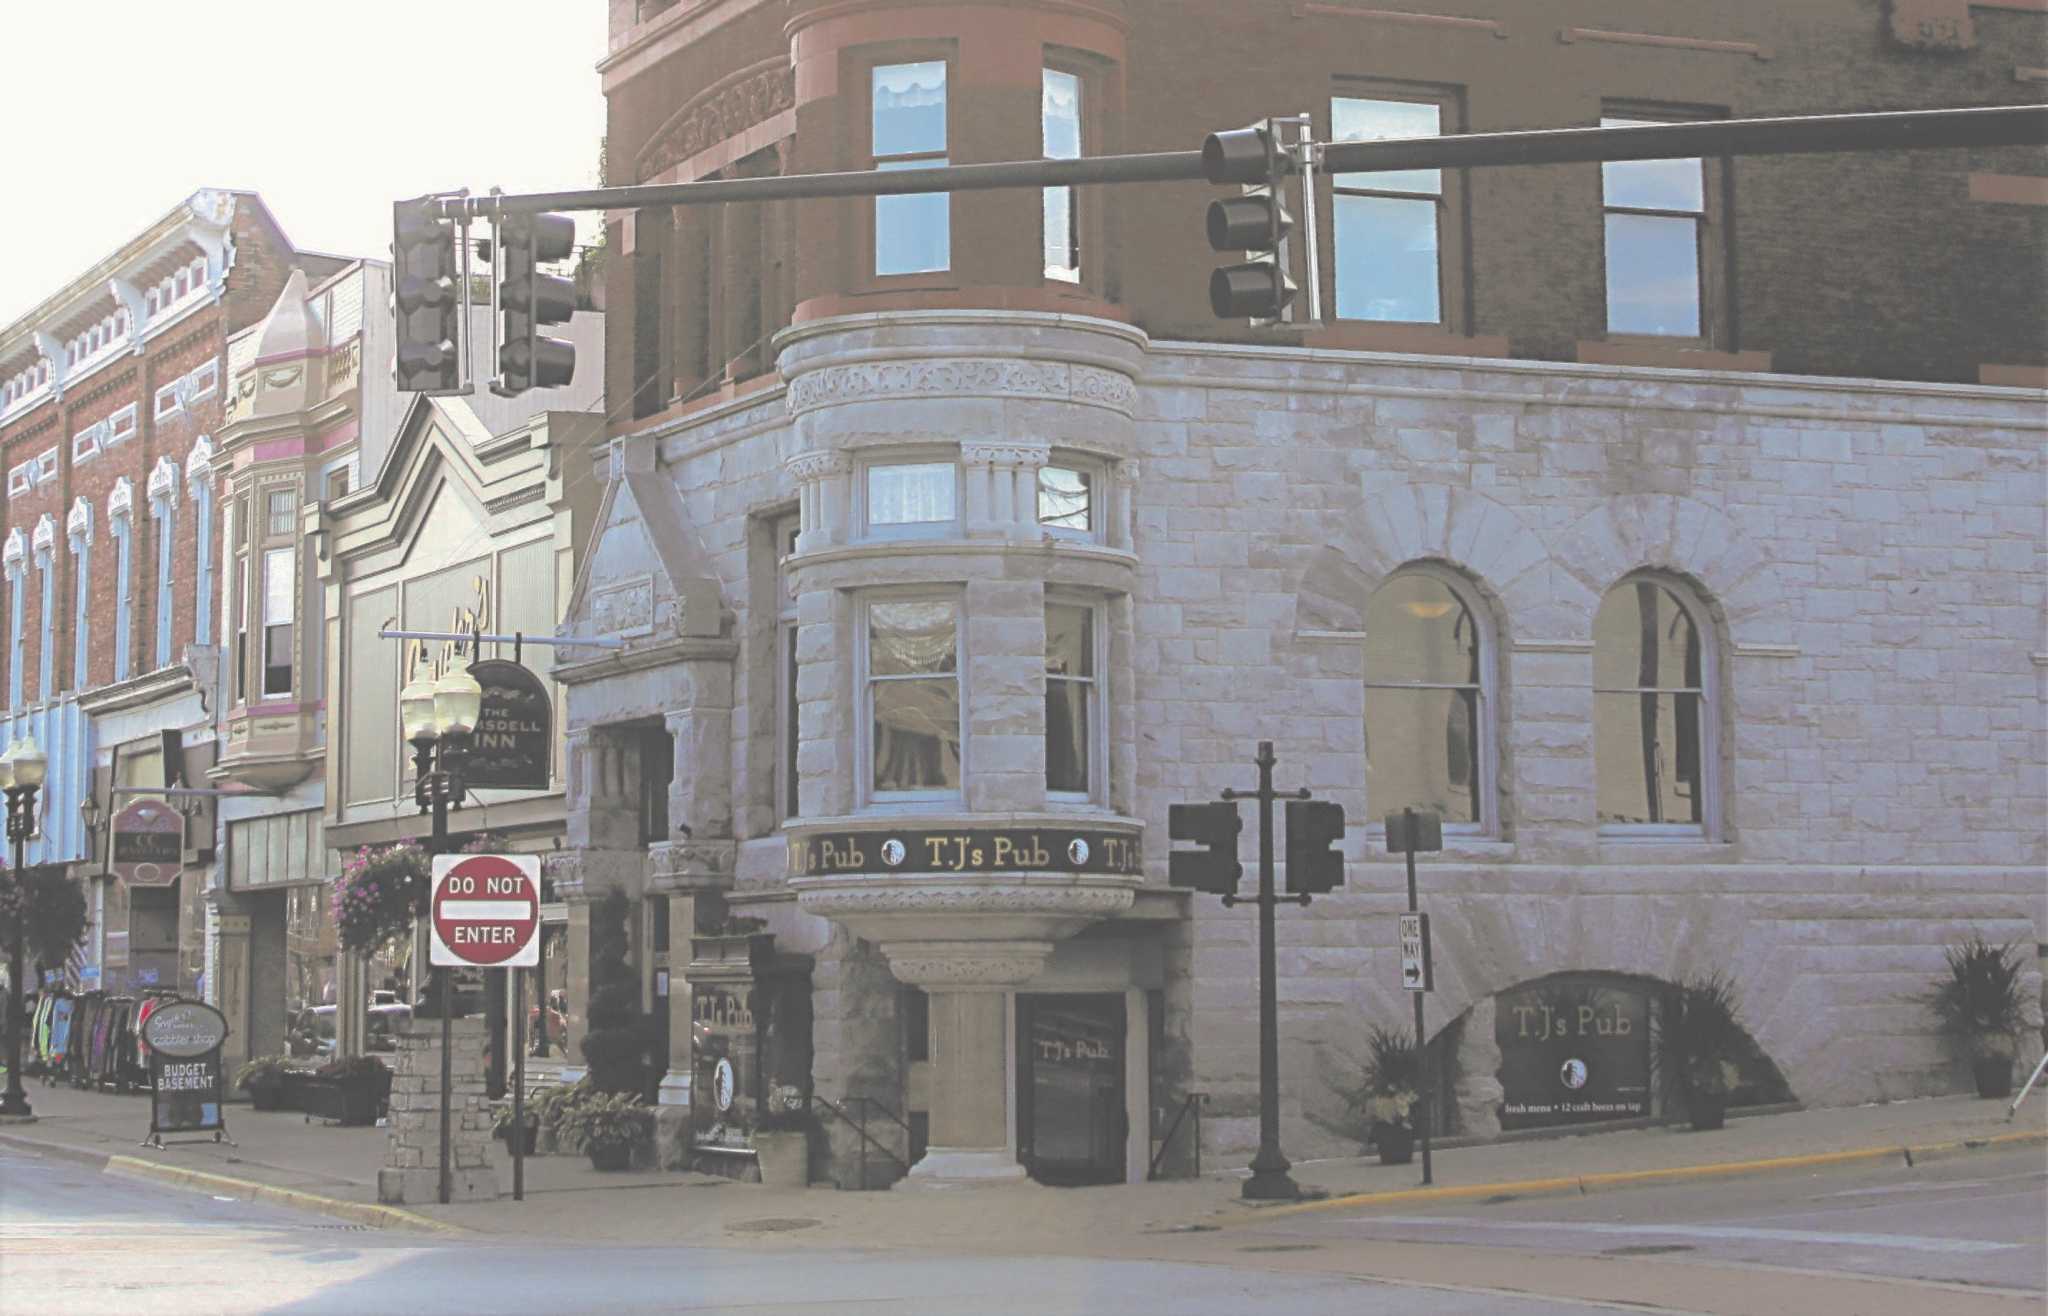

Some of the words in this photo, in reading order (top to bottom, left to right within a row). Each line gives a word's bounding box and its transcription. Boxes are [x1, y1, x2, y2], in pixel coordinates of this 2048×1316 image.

[483, 708, 509, 718] THE
[474, 733, 516, 748] INN
[821, 837, 864, 869] Pub
[925, 837, 984, 871] T.J's
[994, 835, 1050, 867] Pub
[449, 877, 475, 894] DO
[487, 876, 524, 894] NOT
[454, 925, 516, 944] ENTER
[1401, 920, 1419, 938] ONE
[1402, 942, 1420, 960] WAY
[726, 995, 752, 1027] Pub
[1512, 1005, 1568, 1041] T.J's
[1577, 1002, 1632, 1036] Pub
[1076, 1039, 1110, 1059] Pub
[164, 1063, 207, 1077] BUDGET
[158, 1076, 214, 1091] BASEMENT
[1561, 1103, 1571, 1112] 12
